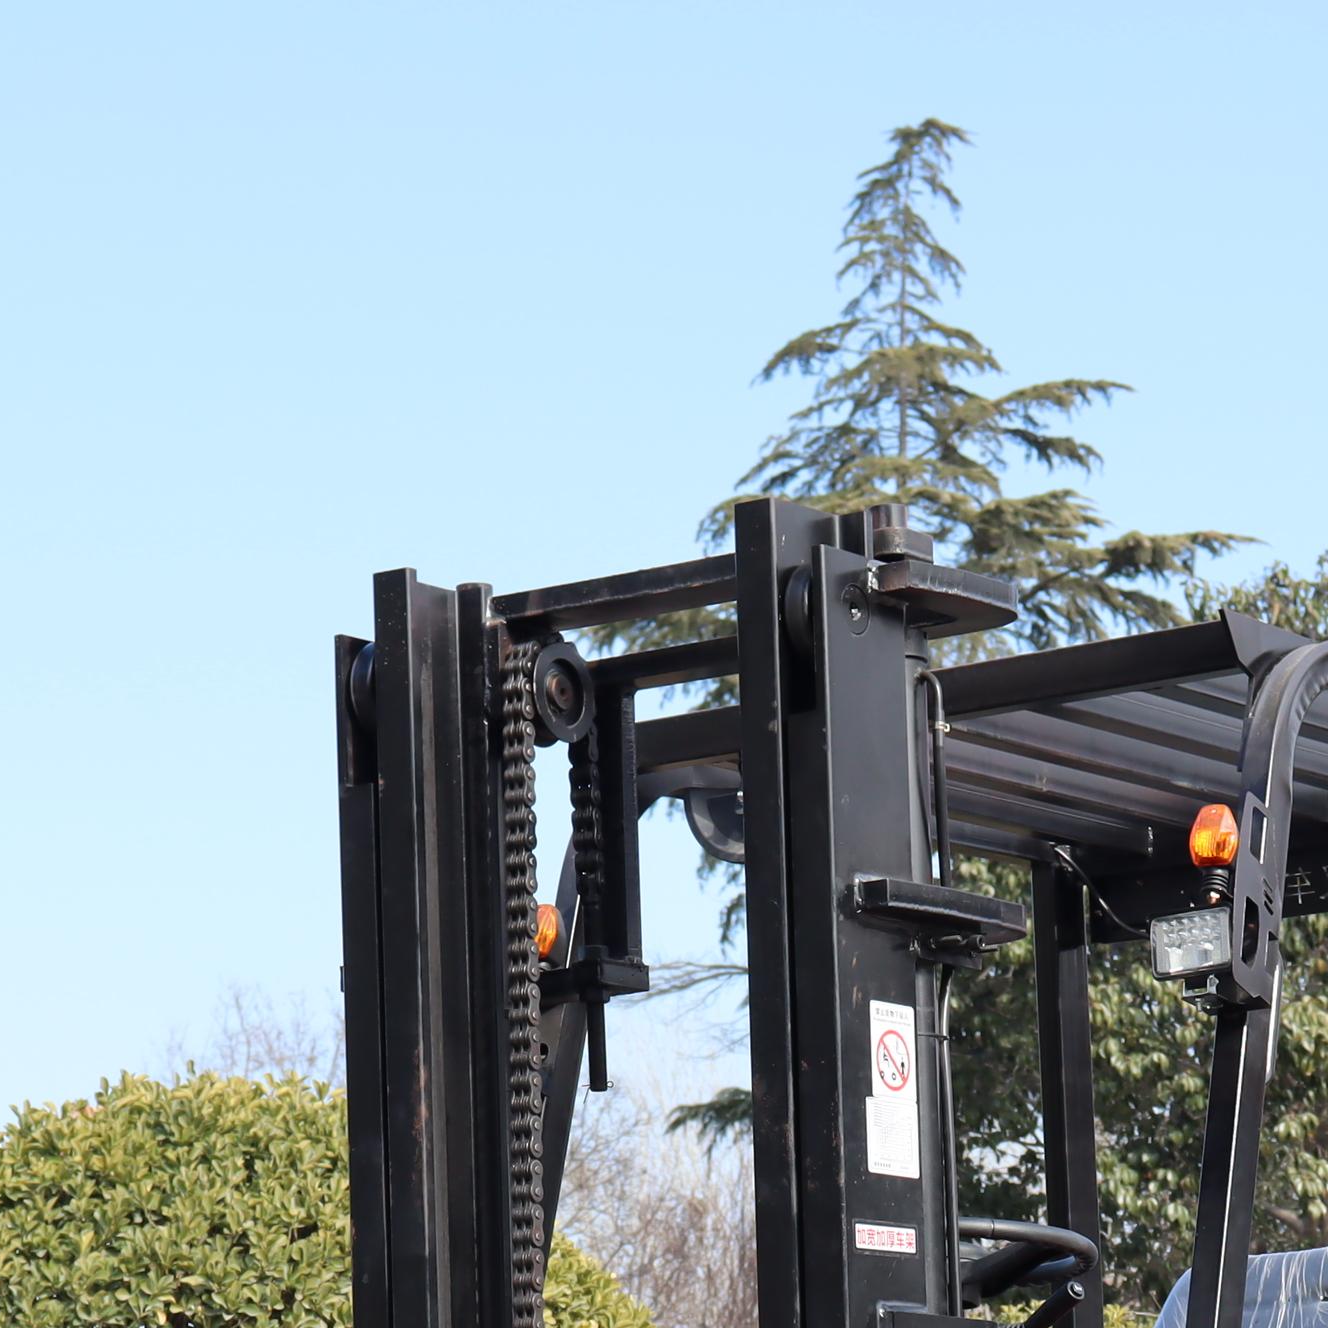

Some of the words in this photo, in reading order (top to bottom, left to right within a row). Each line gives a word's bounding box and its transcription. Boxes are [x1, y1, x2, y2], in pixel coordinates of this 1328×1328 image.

[857, 1228, 915, 1249] 加宽加厚车架
